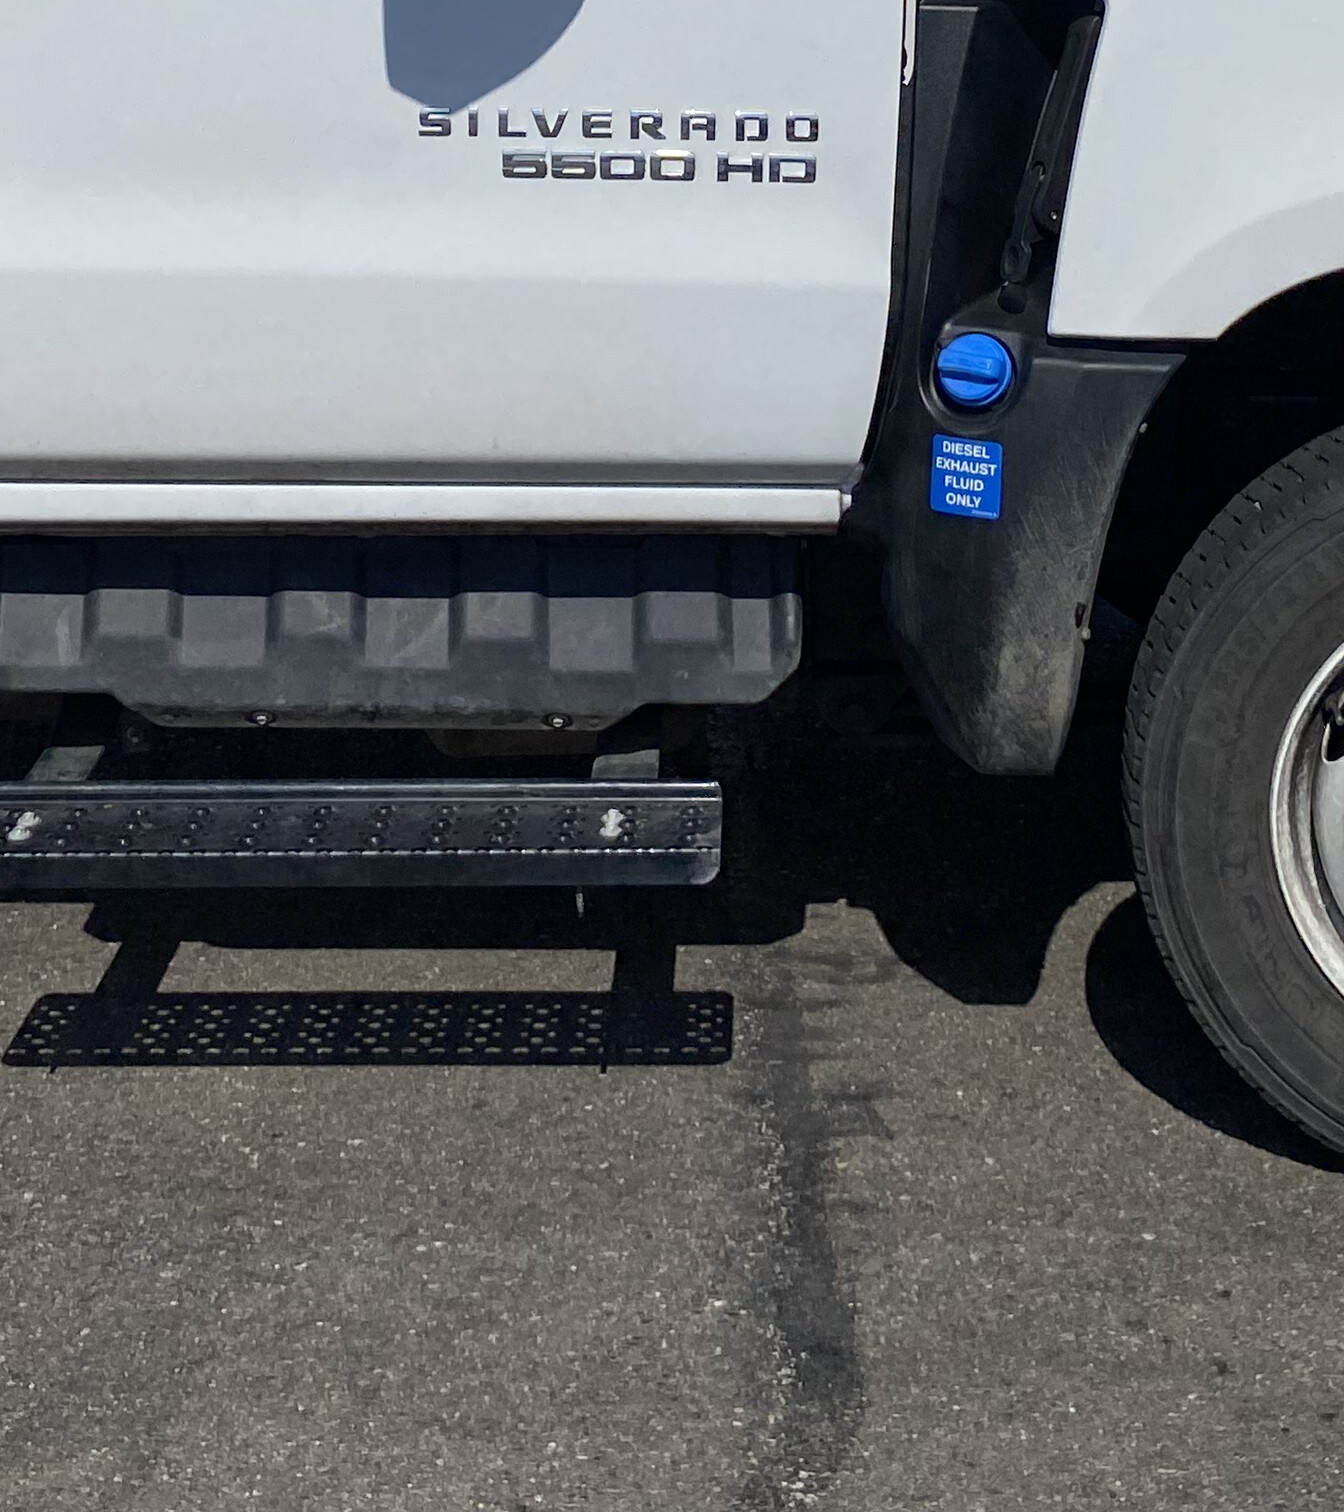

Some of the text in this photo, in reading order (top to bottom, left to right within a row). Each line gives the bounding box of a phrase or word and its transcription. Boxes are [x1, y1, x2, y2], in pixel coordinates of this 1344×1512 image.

[417, 105, 820, 144] SILVERADO
[501, 147, 818, 184] 5500 HD
[942, 440, 991, 459] DIESEL
[936, 456, 998, 476] EXHAUST
[944, 475, 985, 492] FLUID
[945, 492, 982, 508] ONLY
